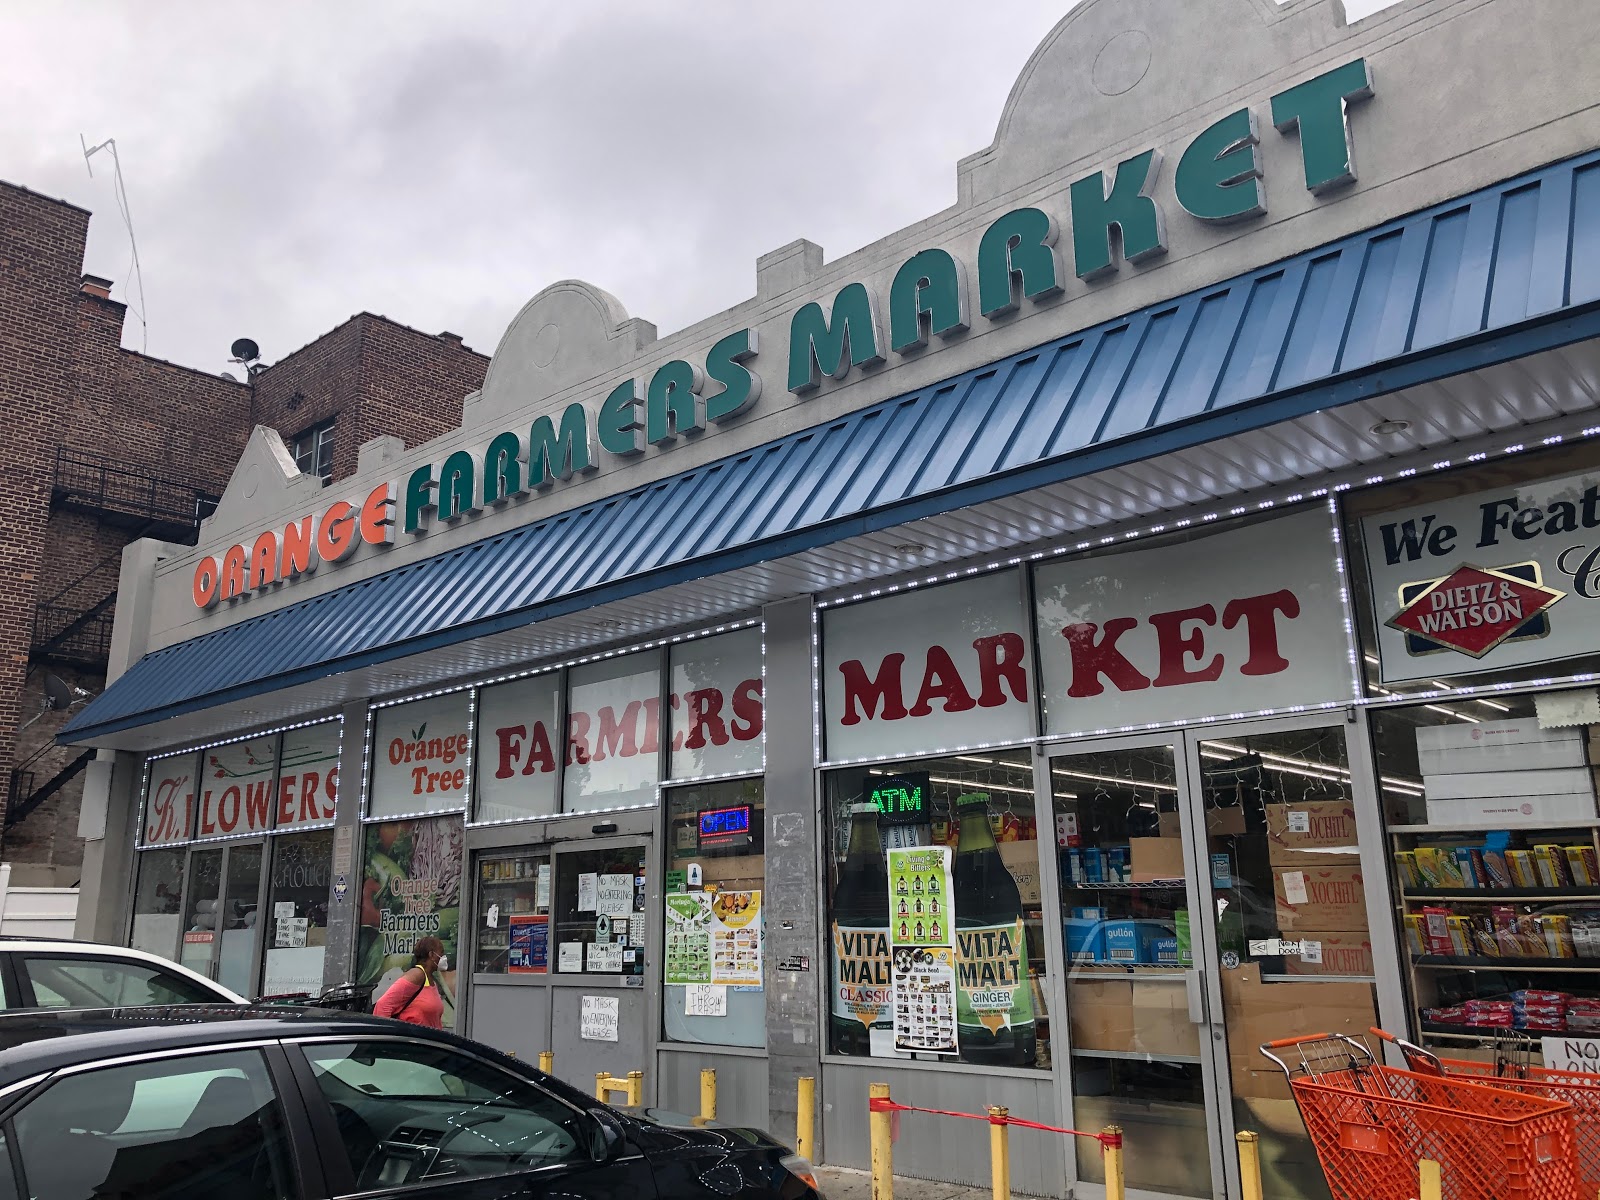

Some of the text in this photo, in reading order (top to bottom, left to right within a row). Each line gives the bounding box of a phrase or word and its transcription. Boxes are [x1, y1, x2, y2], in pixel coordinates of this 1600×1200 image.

[193, 57, 1374, 608] ORANGE FARMERS MARKET
[1379, 514, 1457, 566] We
[1430, 581, 1520, 612] DIETZ &
[1417, 599, 1523, 634] WATSON
[495, 679, 764, 779] FARMERS
[389, 733, 468, 765] Orange
[412, 766, 465, 795] Tree
[870, 786, 921, 813] ATM
[702, 810, 747, 833] OPEN
[391, 875, 438, 898] Orange
[610, 875, 631, 888] MASK
[403, 895, 431, 914] Tree
[600, 902, 624, 913] PLEASE
[379, 909, 440, 932] Farmers
[383, 932, 421, 954] Mar
[842, 931, 889, 957] VITA
[958, 930, 1014, 958] VITA
[1107, 927, 1134, 939] gullón
[840, 958, 892, 985] MALT
[959, 959, 1020, 988] MALT
[691, 993, 723, 1006] THROW
[697, 985, 711, 993] NO
[840, 987, 893, 1003] CLASSIC
[972, 991, 1011, 1003] GINGER
[583, 997, 618, 1014] NO MASK
[691, 1004, 721, 1015] TRASH
[585, 1026, 612, 1038] PLEASE
[1564, 1040, 1600, 1060] NO
